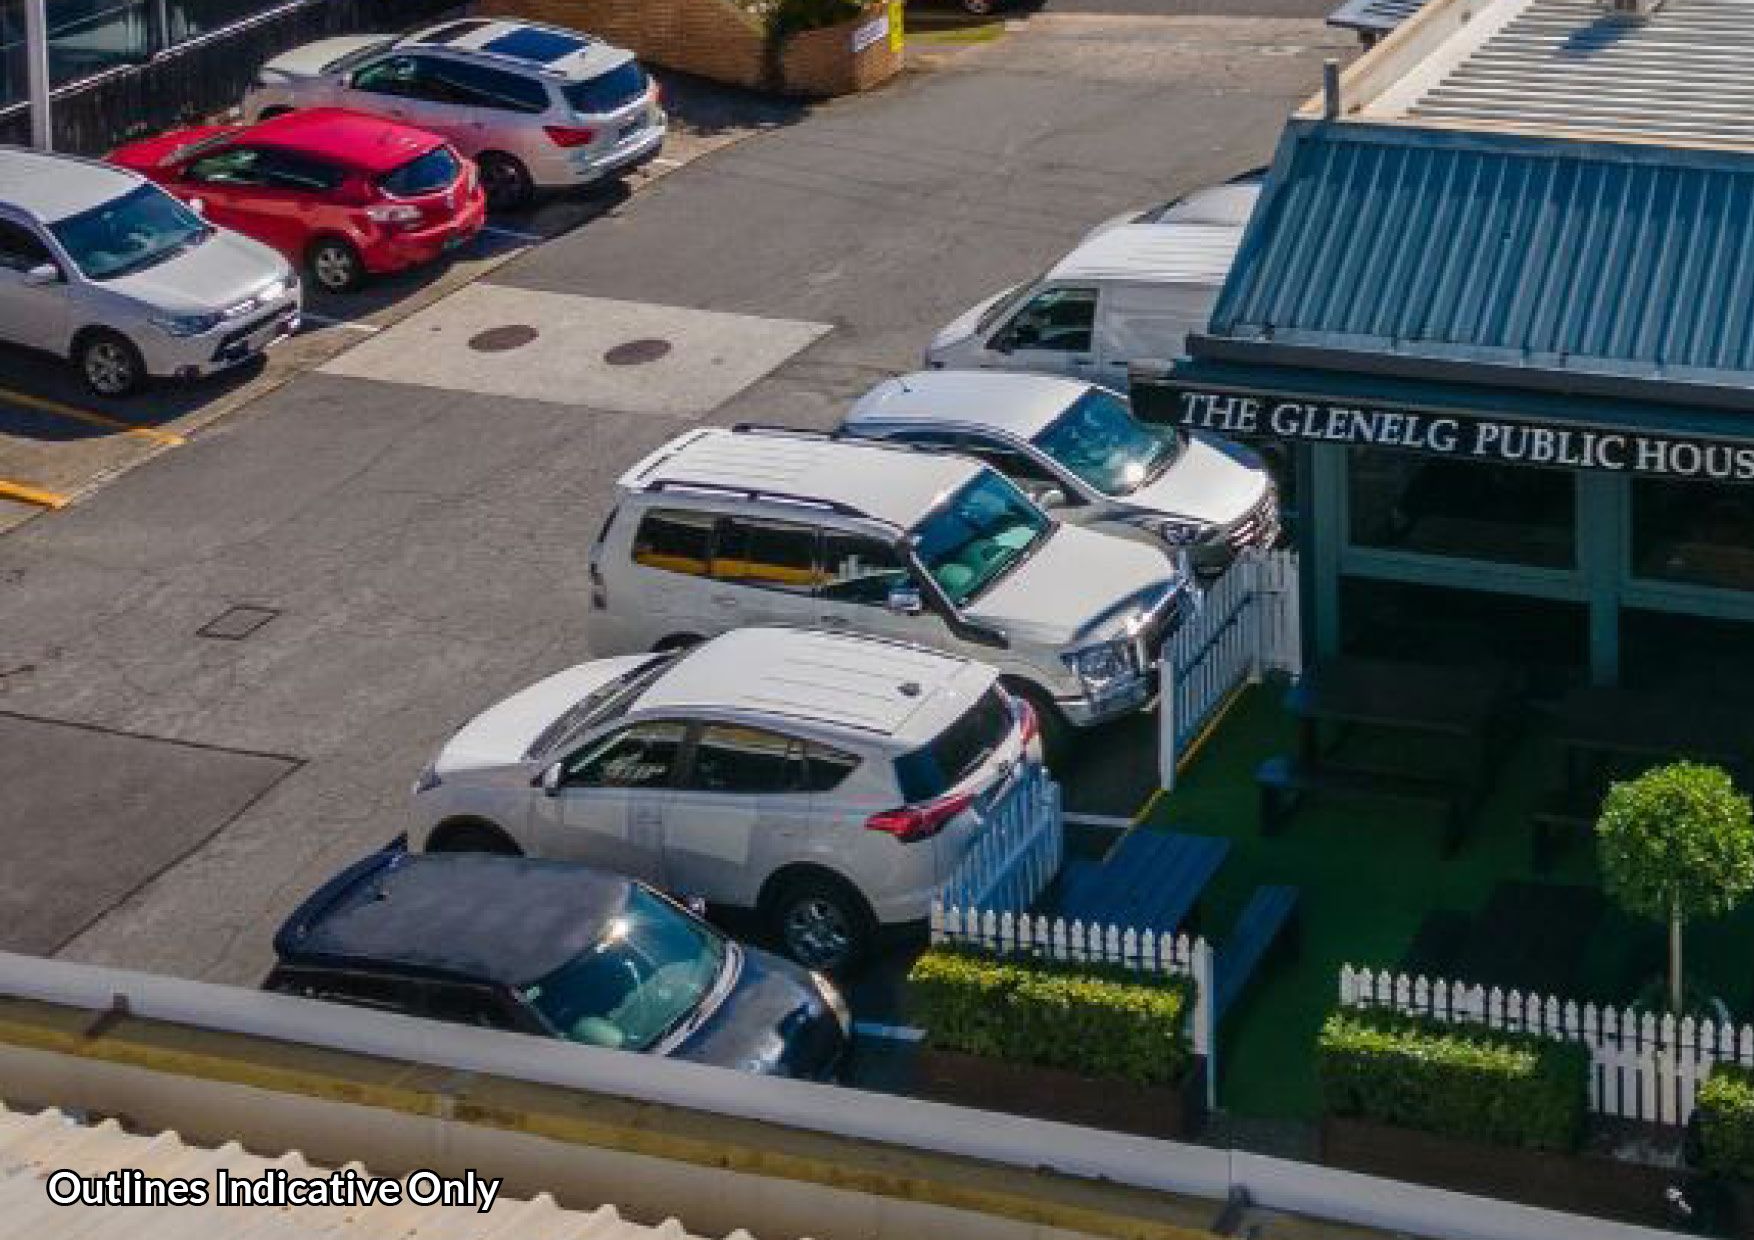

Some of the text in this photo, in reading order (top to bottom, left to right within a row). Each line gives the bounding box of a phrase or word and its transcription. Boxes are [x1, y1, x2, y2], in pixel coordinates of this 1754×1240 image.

[1180, 391, 1260, 432] THE
[1270, 403, 1458, 452] GLENELG
[1472, 422, 1626, 469] PUBLIC
